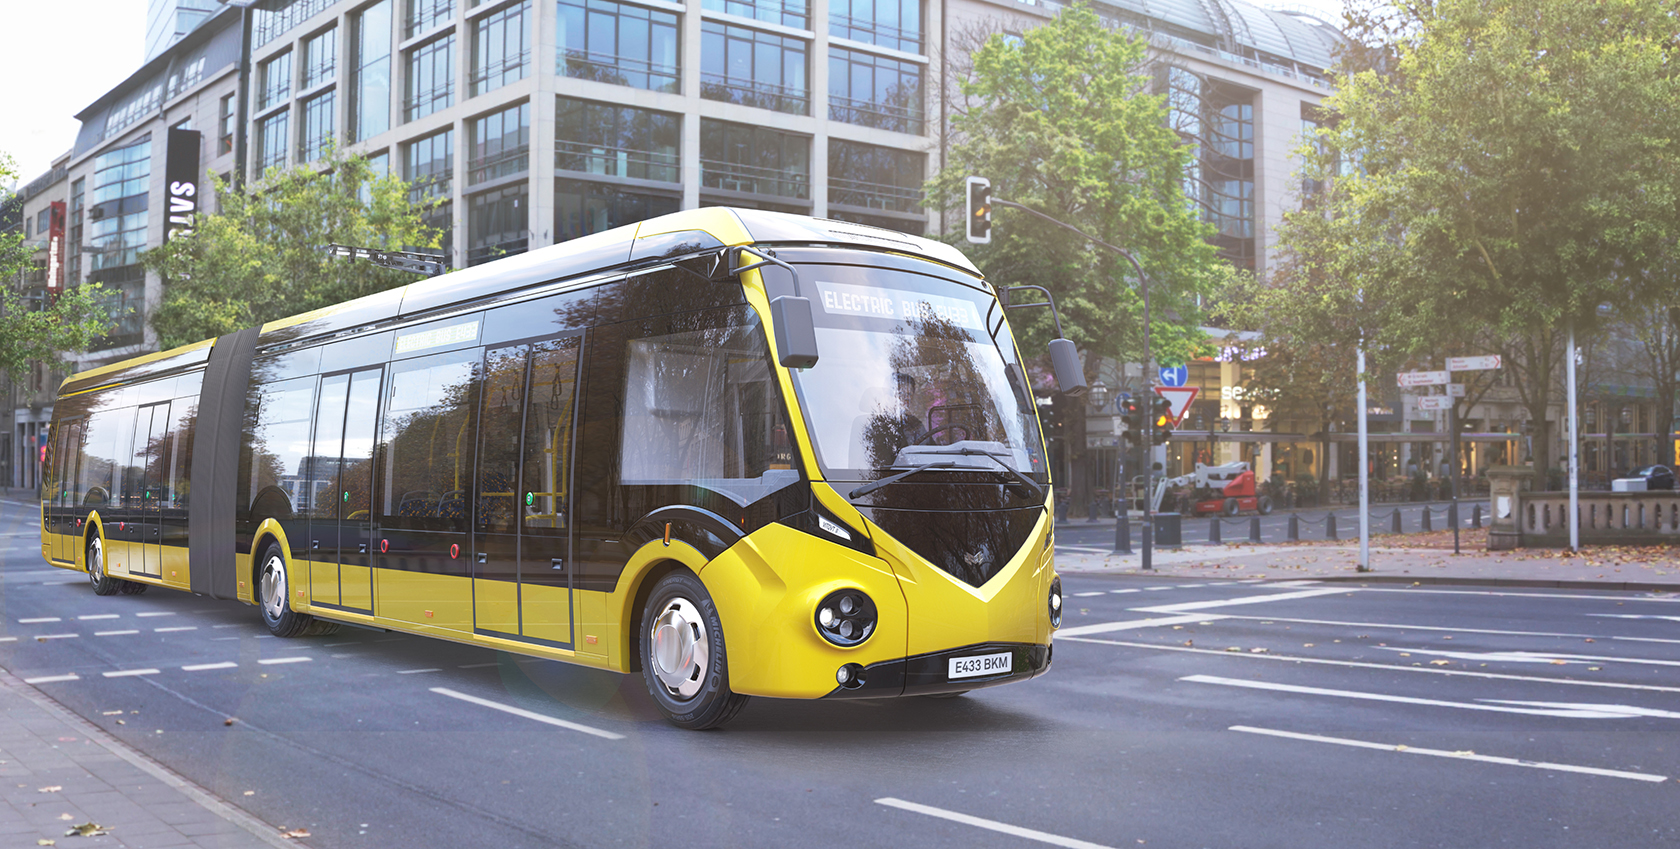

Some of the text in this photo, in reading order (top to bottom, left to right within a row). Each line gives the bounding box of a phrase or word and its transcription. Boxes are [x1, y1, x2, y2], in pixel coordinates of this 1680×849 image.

[824, 290, 894, 315] ELECTRIC
[902, 300, 928, 318] BUS
[399, 332, 432, 351] ELECTRIC
[435, 328, 452, 344] BUS
[710, 616, 723, 674] MICHELIN
[955, 656, 1007, 674] E433 BKM
